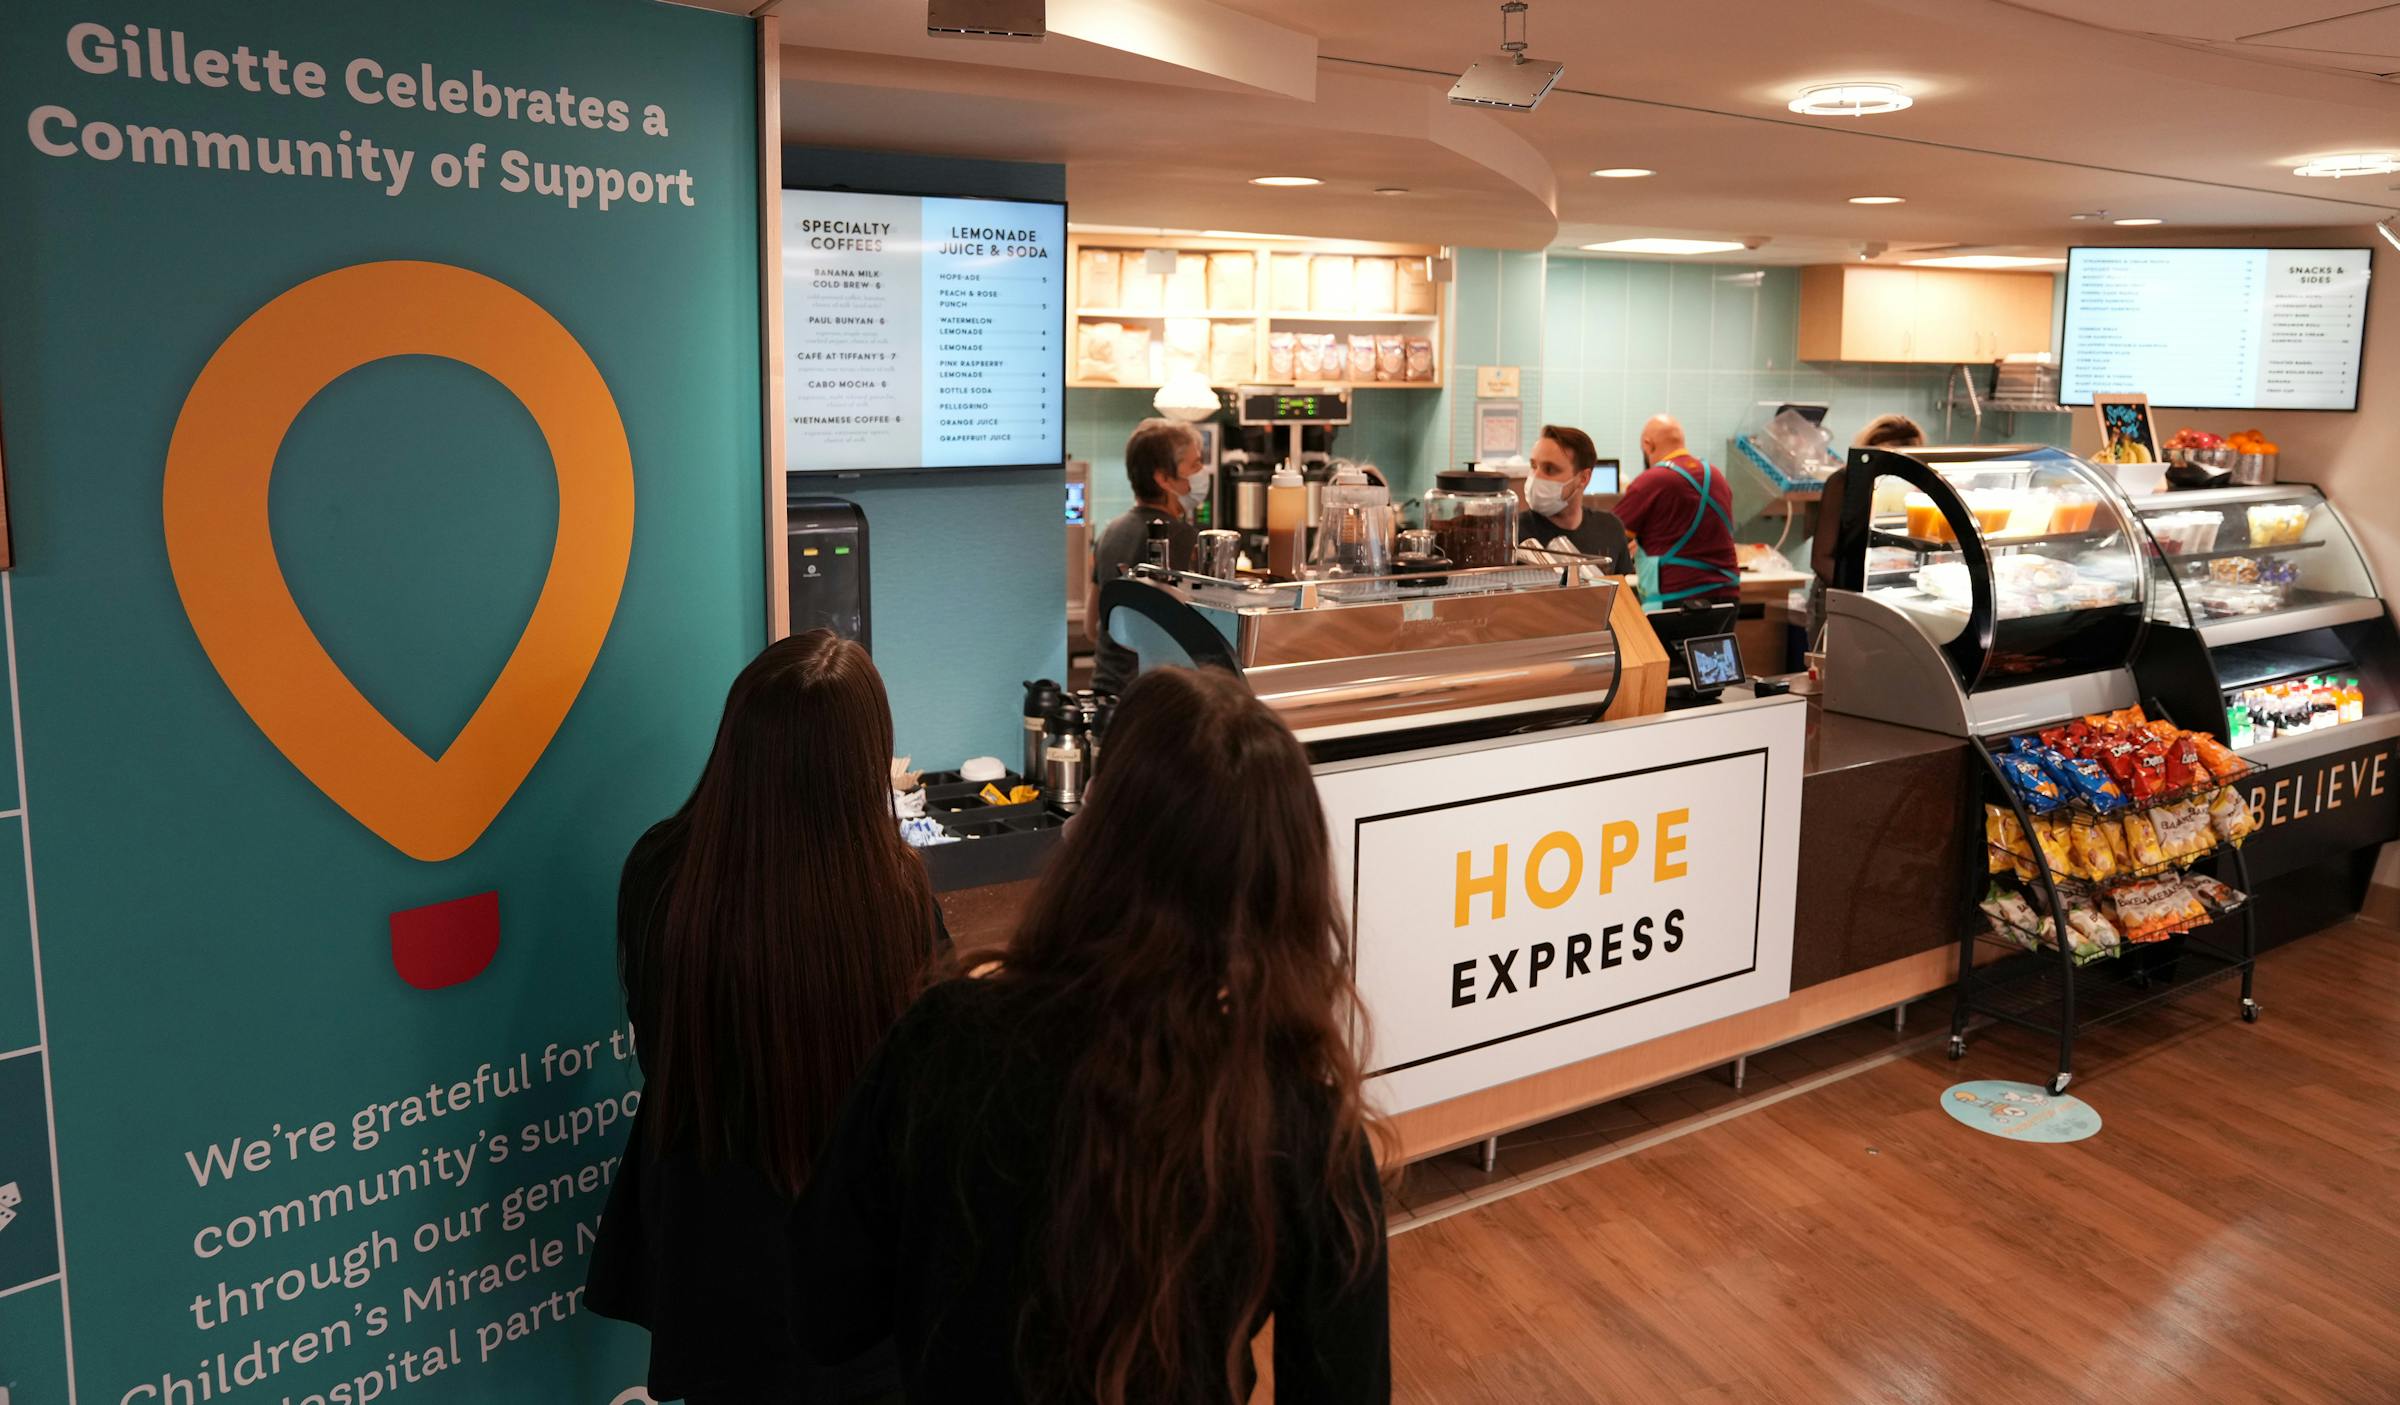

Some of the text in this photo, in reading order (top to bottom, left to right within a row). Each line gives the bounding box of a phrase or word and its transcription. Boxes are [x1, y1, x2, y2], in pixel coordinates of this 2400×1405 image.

[66, 22, 669, 137] Gillette Celebrates a
[27, 104, 695, 211] Community of Support
[802, 219, 890, 235] SPECIALTY
[952, 226, 1036, 242] LEMONADE
[811, 237, 882, 252] COFFEES
[939, 243, 1048, 258] JUICE & SODA
[814, 269, 880, 278] BANANA MILK
[2288, 266, 2345, 275] SNACKS &
[813, 281, 840, 289] COLD
[843, 281, 869, 289] BREW
[2300, 276, 2331, 284] SIDES
[977, 290, 998, 298] ROSE
[809, 316, 832, 324] PAUL
[835, 316, 874, 325] BUNYAN
[826, 352, 836, 360] AT
[793, 416, 852, 424] VIETNAMESE
[854, 416, 889, 424] COFFEE
[940, 434, 987, 442] GRAPEFRUIT
[2250, 752, 2388, 831] BELIEVE
[1454, 807, 1690, 928] HOPE
[1451, 908, 1685, 1009] EXPRESS
[185, 1121, 337, 1188] We're
[352, 1053, 532, 1151] grateful
[541, 1043, 600, 1082] for
[193, 1130, 509, 1258] community's
[189, 1155, 624, 1330] through our gener
[119, 1302, 389, 1405] Children's
[403, 1238, 565, 1323] Miracle
[282, 1328, 461, 1405] spital
